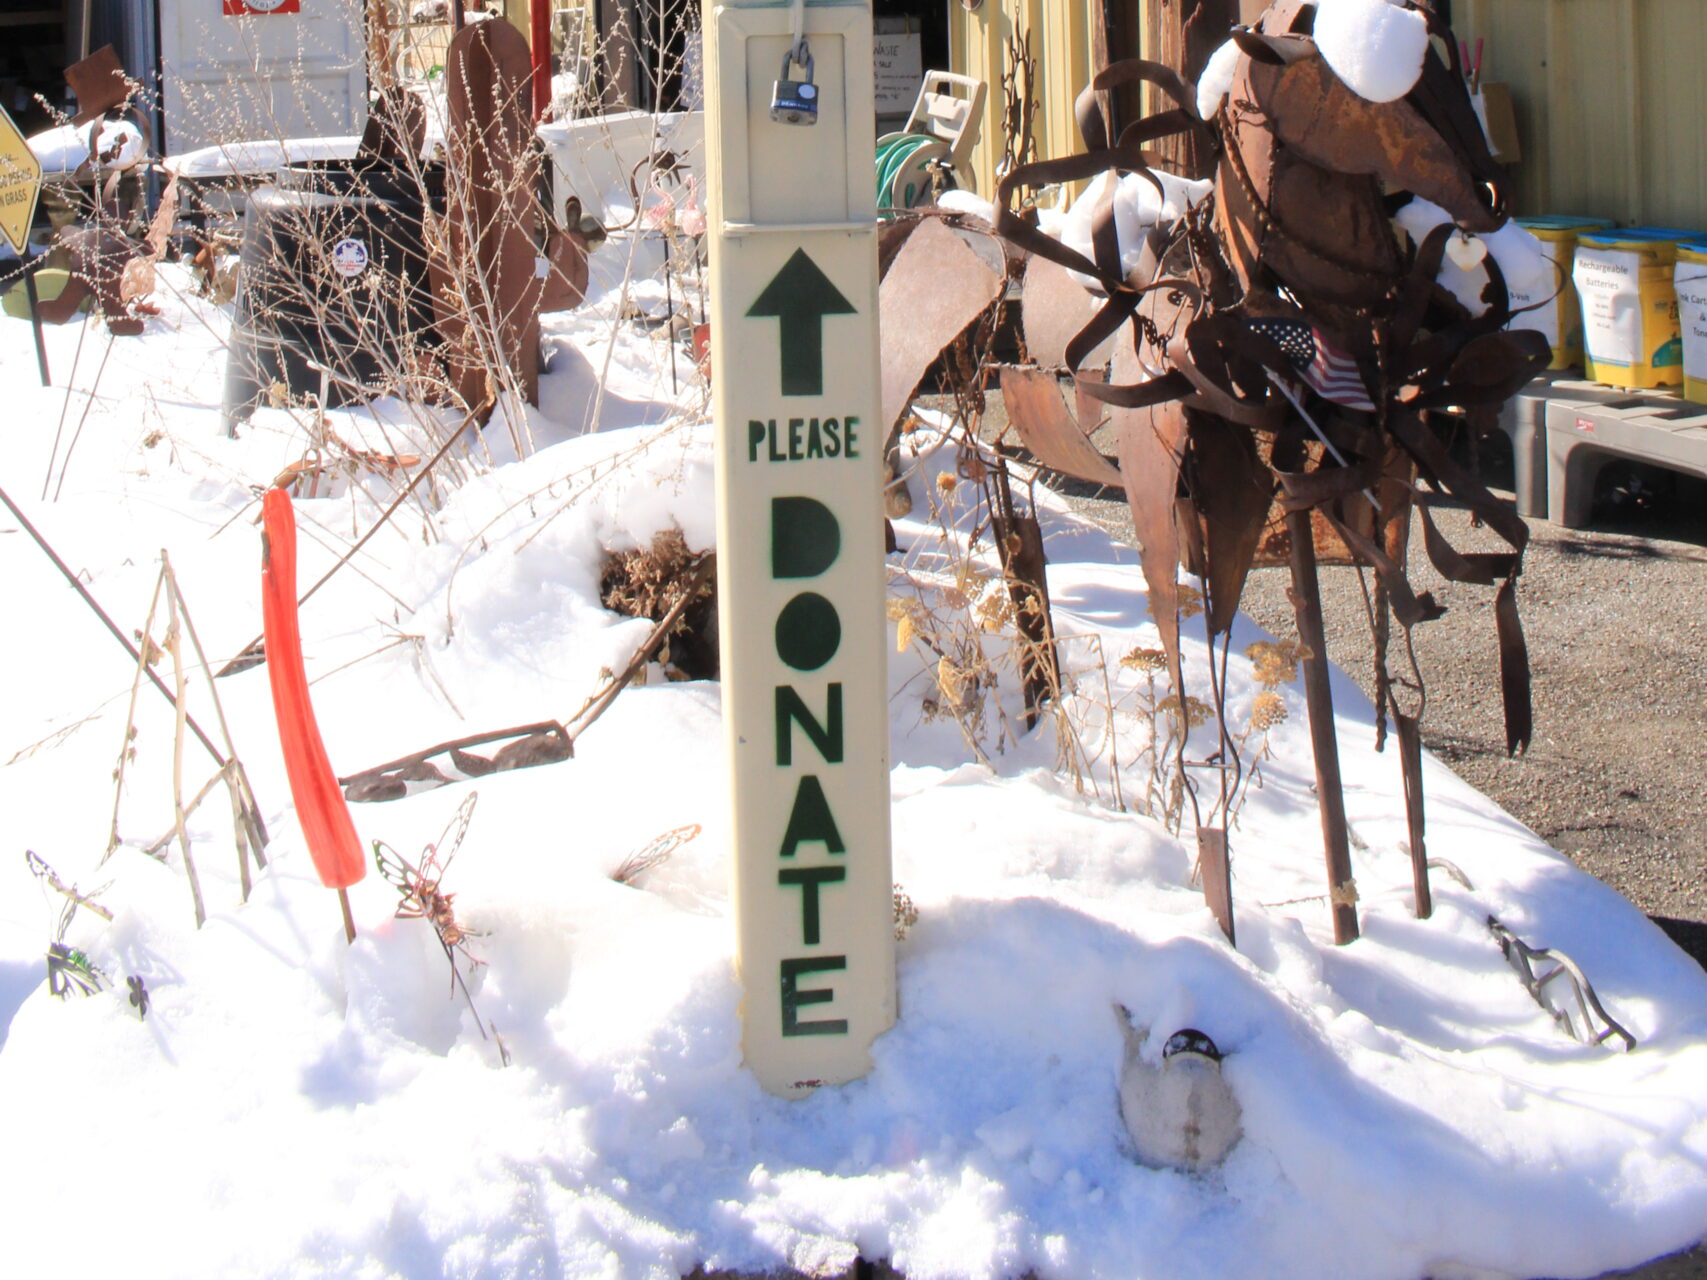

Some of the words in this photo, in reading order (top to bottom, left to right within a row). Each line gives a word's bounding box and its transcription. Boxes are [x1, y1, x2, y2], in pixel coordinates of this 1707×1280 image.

[5, 188, 27, 206] GRASS
[1578, 259, 1629, 275] Rechargeable
[1586, 277, 1620, 290] Batteries
[1699, 312, 1706, 321] &
[748, 416, 861, 463] PLEASE
[770, 494, 850, 1038] DONATE
